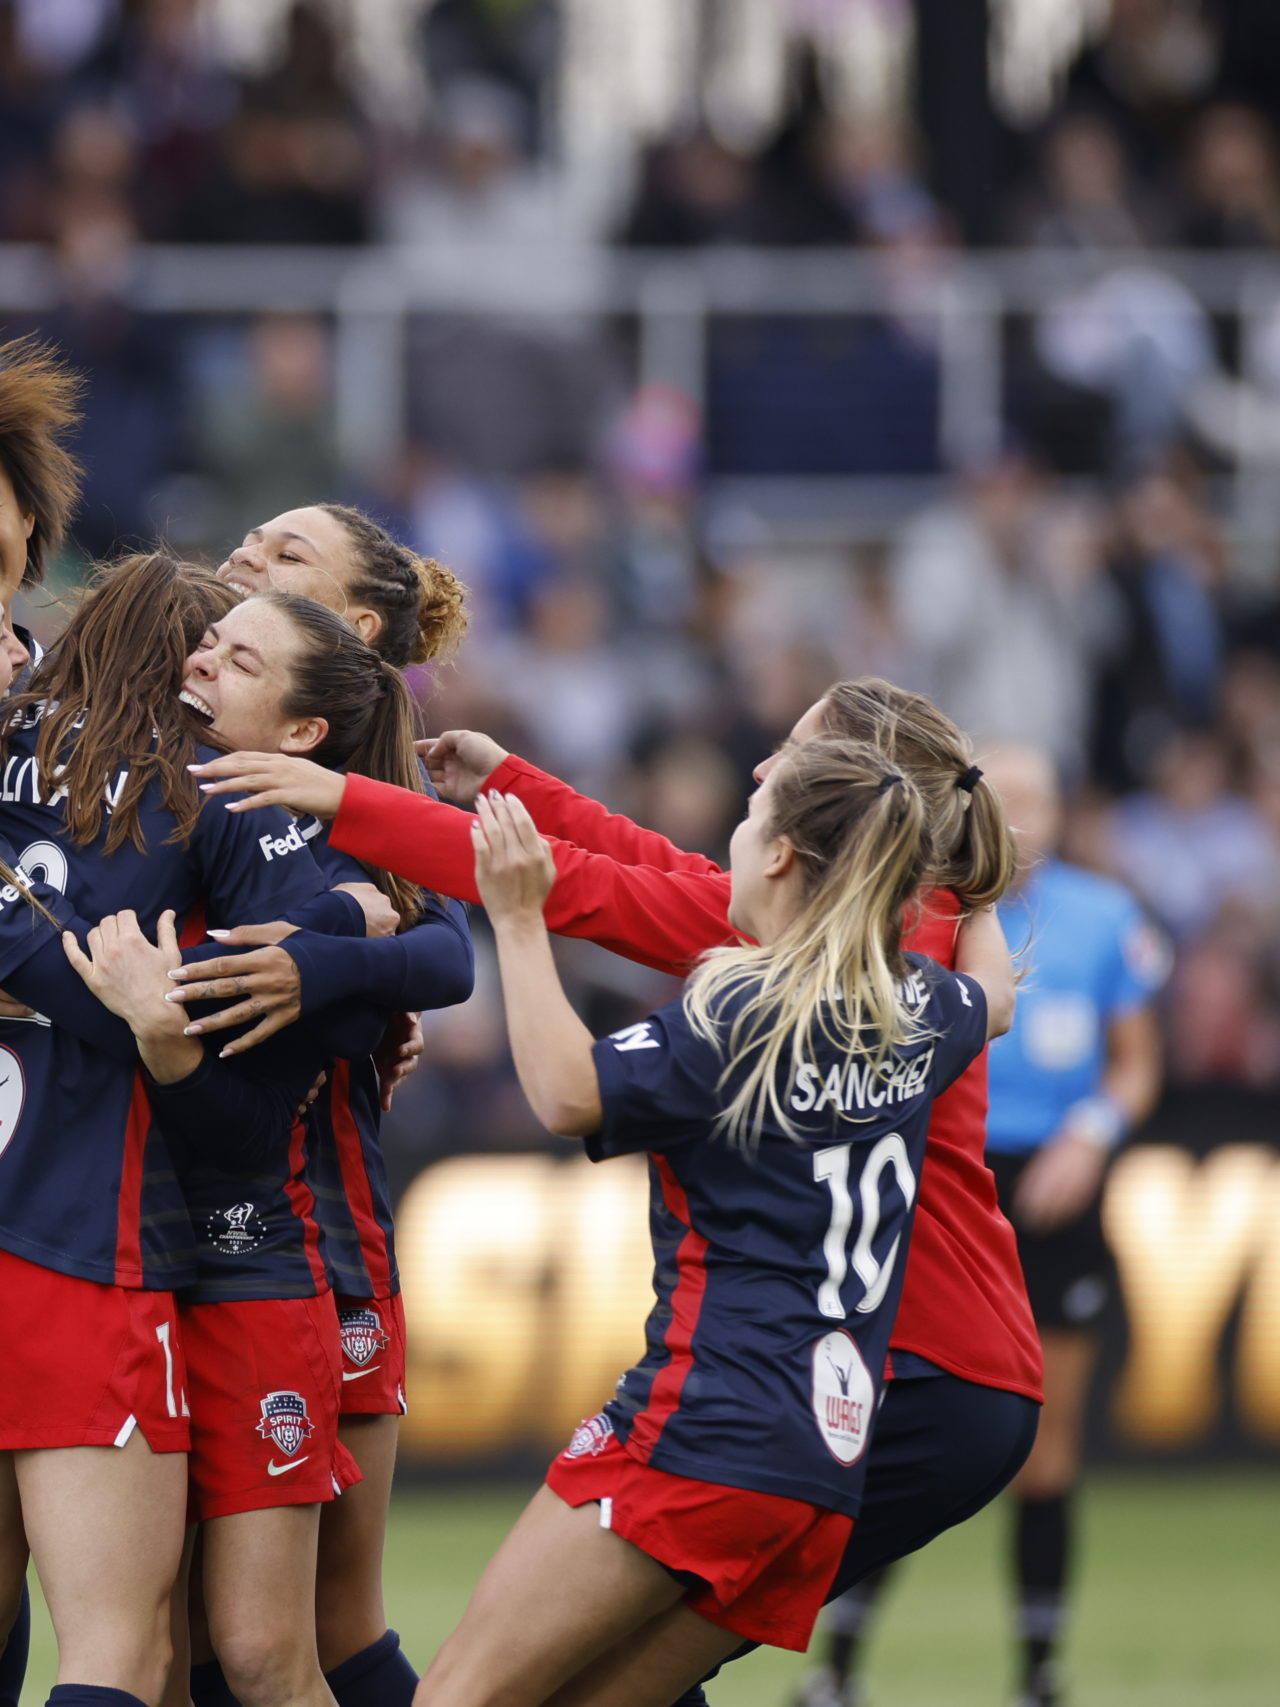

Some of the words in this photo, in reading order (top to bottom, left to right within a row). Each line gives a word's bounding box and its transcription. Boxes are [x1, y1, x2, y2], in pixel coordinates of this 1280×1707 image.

[791, 1047, 935, 1112] SANCHEZ
[813, 1133, 916, 1320] 10
[340, 1327, 375, 1337] SPIRIT
[155, 1320, 192, 1418] 1
[270, 1415, 303, 1426] SPIRIT
